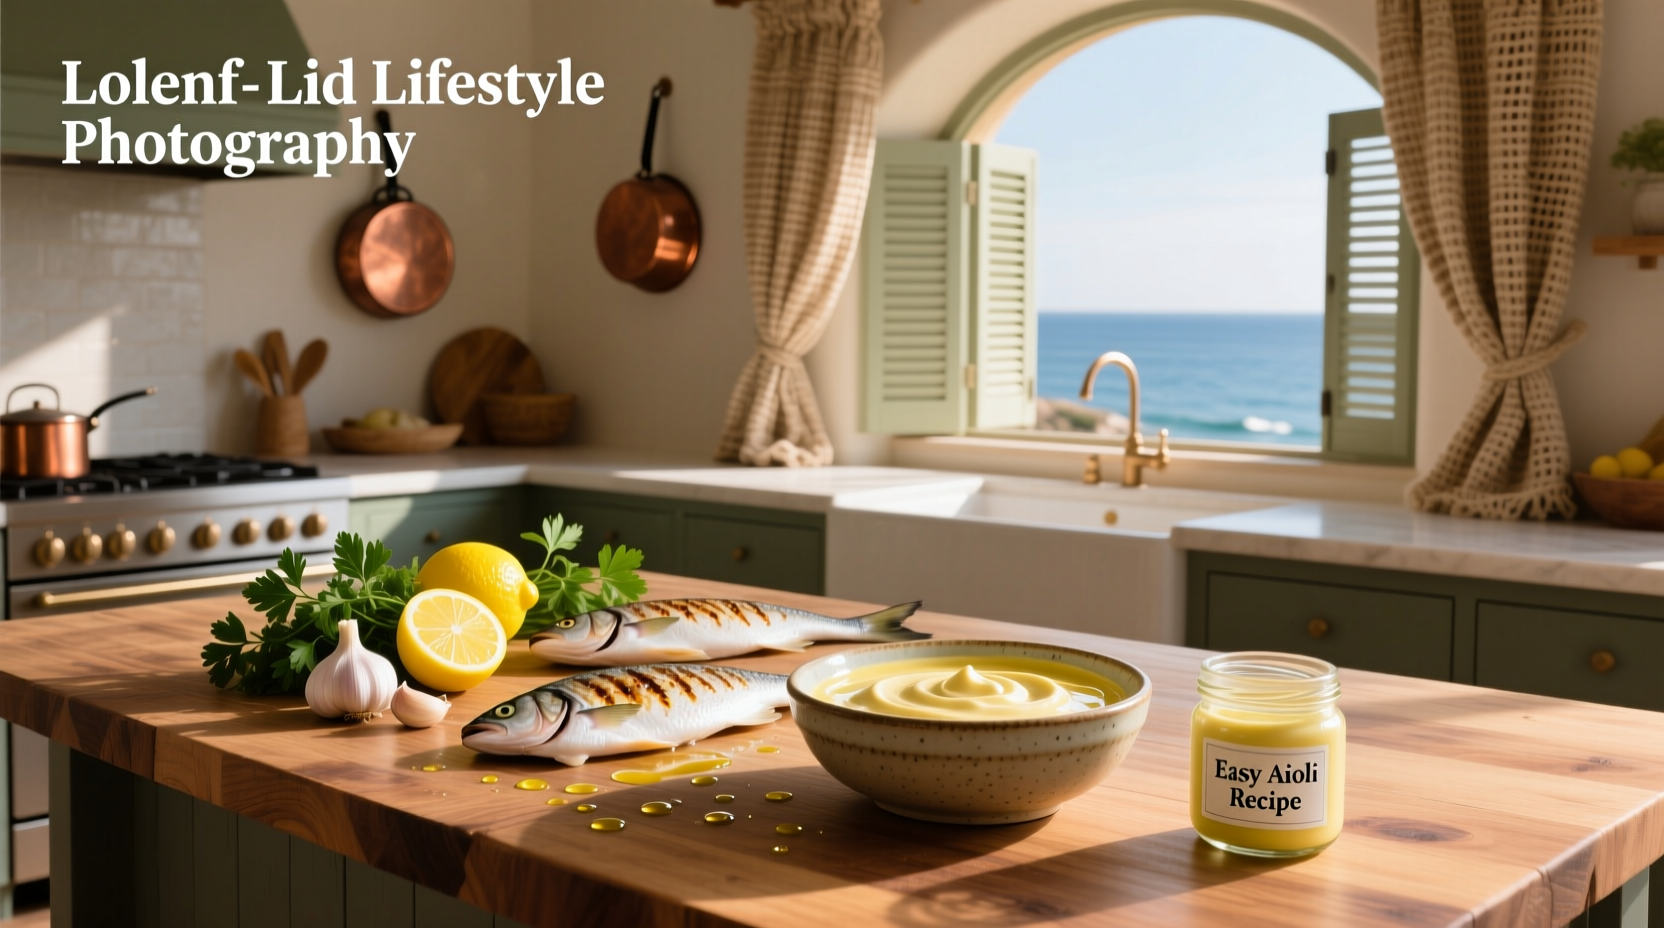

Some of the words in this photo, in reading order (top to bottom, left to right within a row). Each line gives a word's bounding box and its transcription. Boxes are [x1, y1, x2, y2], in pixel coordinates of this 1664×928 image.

[1214, 758, 1263, 788] Easy
[1267, 762, 1318, 784] Aioli
[1229, 787, 1302, 817] Recipe
